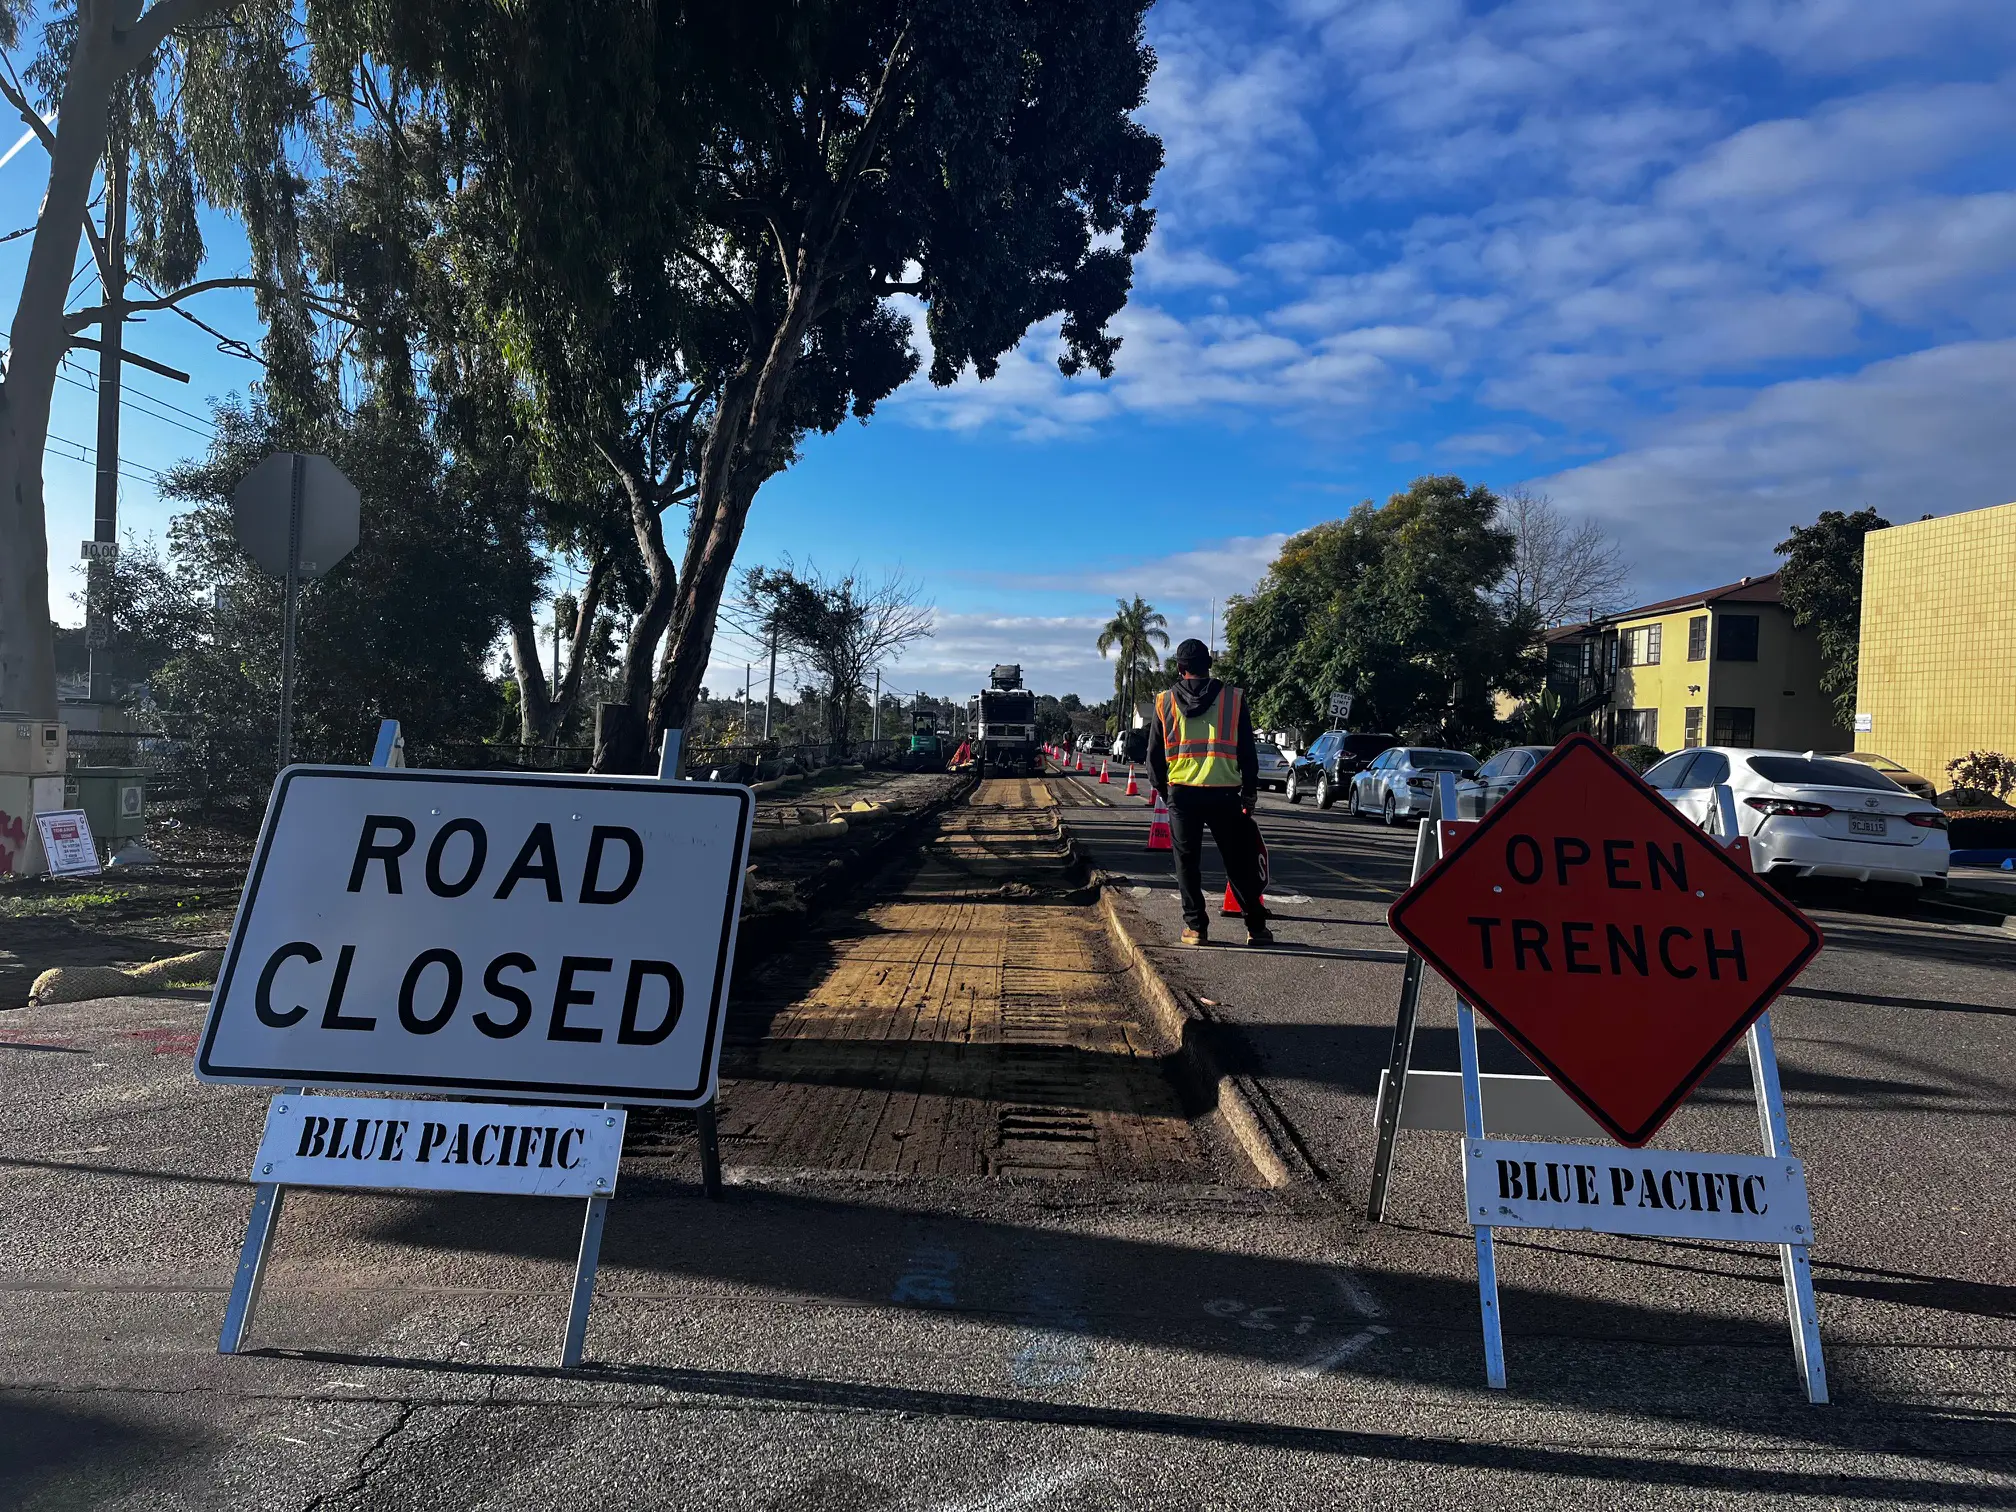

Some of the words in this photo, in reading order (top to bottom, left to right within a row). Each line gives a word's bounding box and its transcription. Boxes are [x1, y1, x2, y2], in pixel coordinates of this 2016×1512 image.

[1330, 704, 1348, 717] 30
[1333, 693, 1351, 701] SPEED
[1852, 821, 1884, 833] 9CJB115
[346, 814, 644, 905] ROAD
[1505, 834, 1690, 893] OPEN
[1467, 916, 1748, 982] TRENCH
[254, 941, 685, 1046] CLOSED
[295, 1115, 411, 1162] BLUE
[414, 1122, 585, 1170] PACIFIC
[1496, 1159, 1600, 1206] BLUE
[1608, 1166, 1769, 1216] PACIFIC
